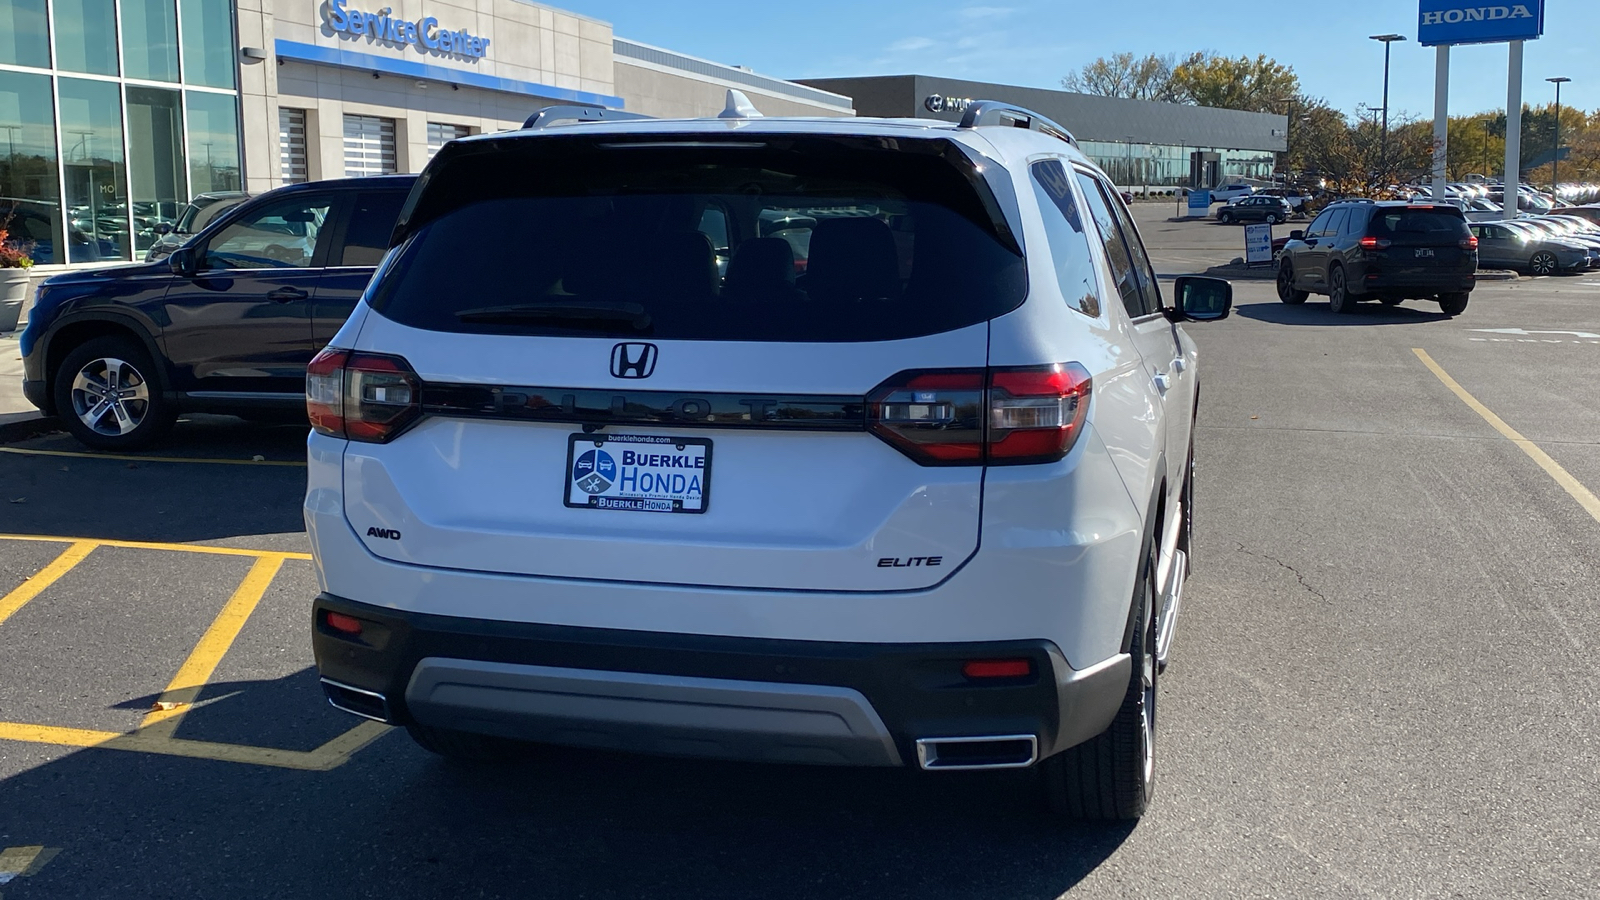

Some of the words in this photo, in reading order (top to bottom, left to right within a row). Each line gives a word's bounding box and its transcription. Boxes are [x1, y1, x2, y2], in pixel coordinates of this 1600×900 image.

[1421, 5, 1533, 25] HONDA
[327, 0, 417, 44] Service
[418, 16, 491, 58] Center
[494, 391, 778, 422] PILOT
[608, 434, 671, 444] buerklehonda.com
[622, 450, 705, 469] BUERKLE
[619, 466, 702, 495] HONDA
[598, 497, 644, 509] BUERKLE
[643, 500, 671, 511] HONDA
[366, 526, 402, 541] AWD
[876, 556, 943, 568] ELITE
